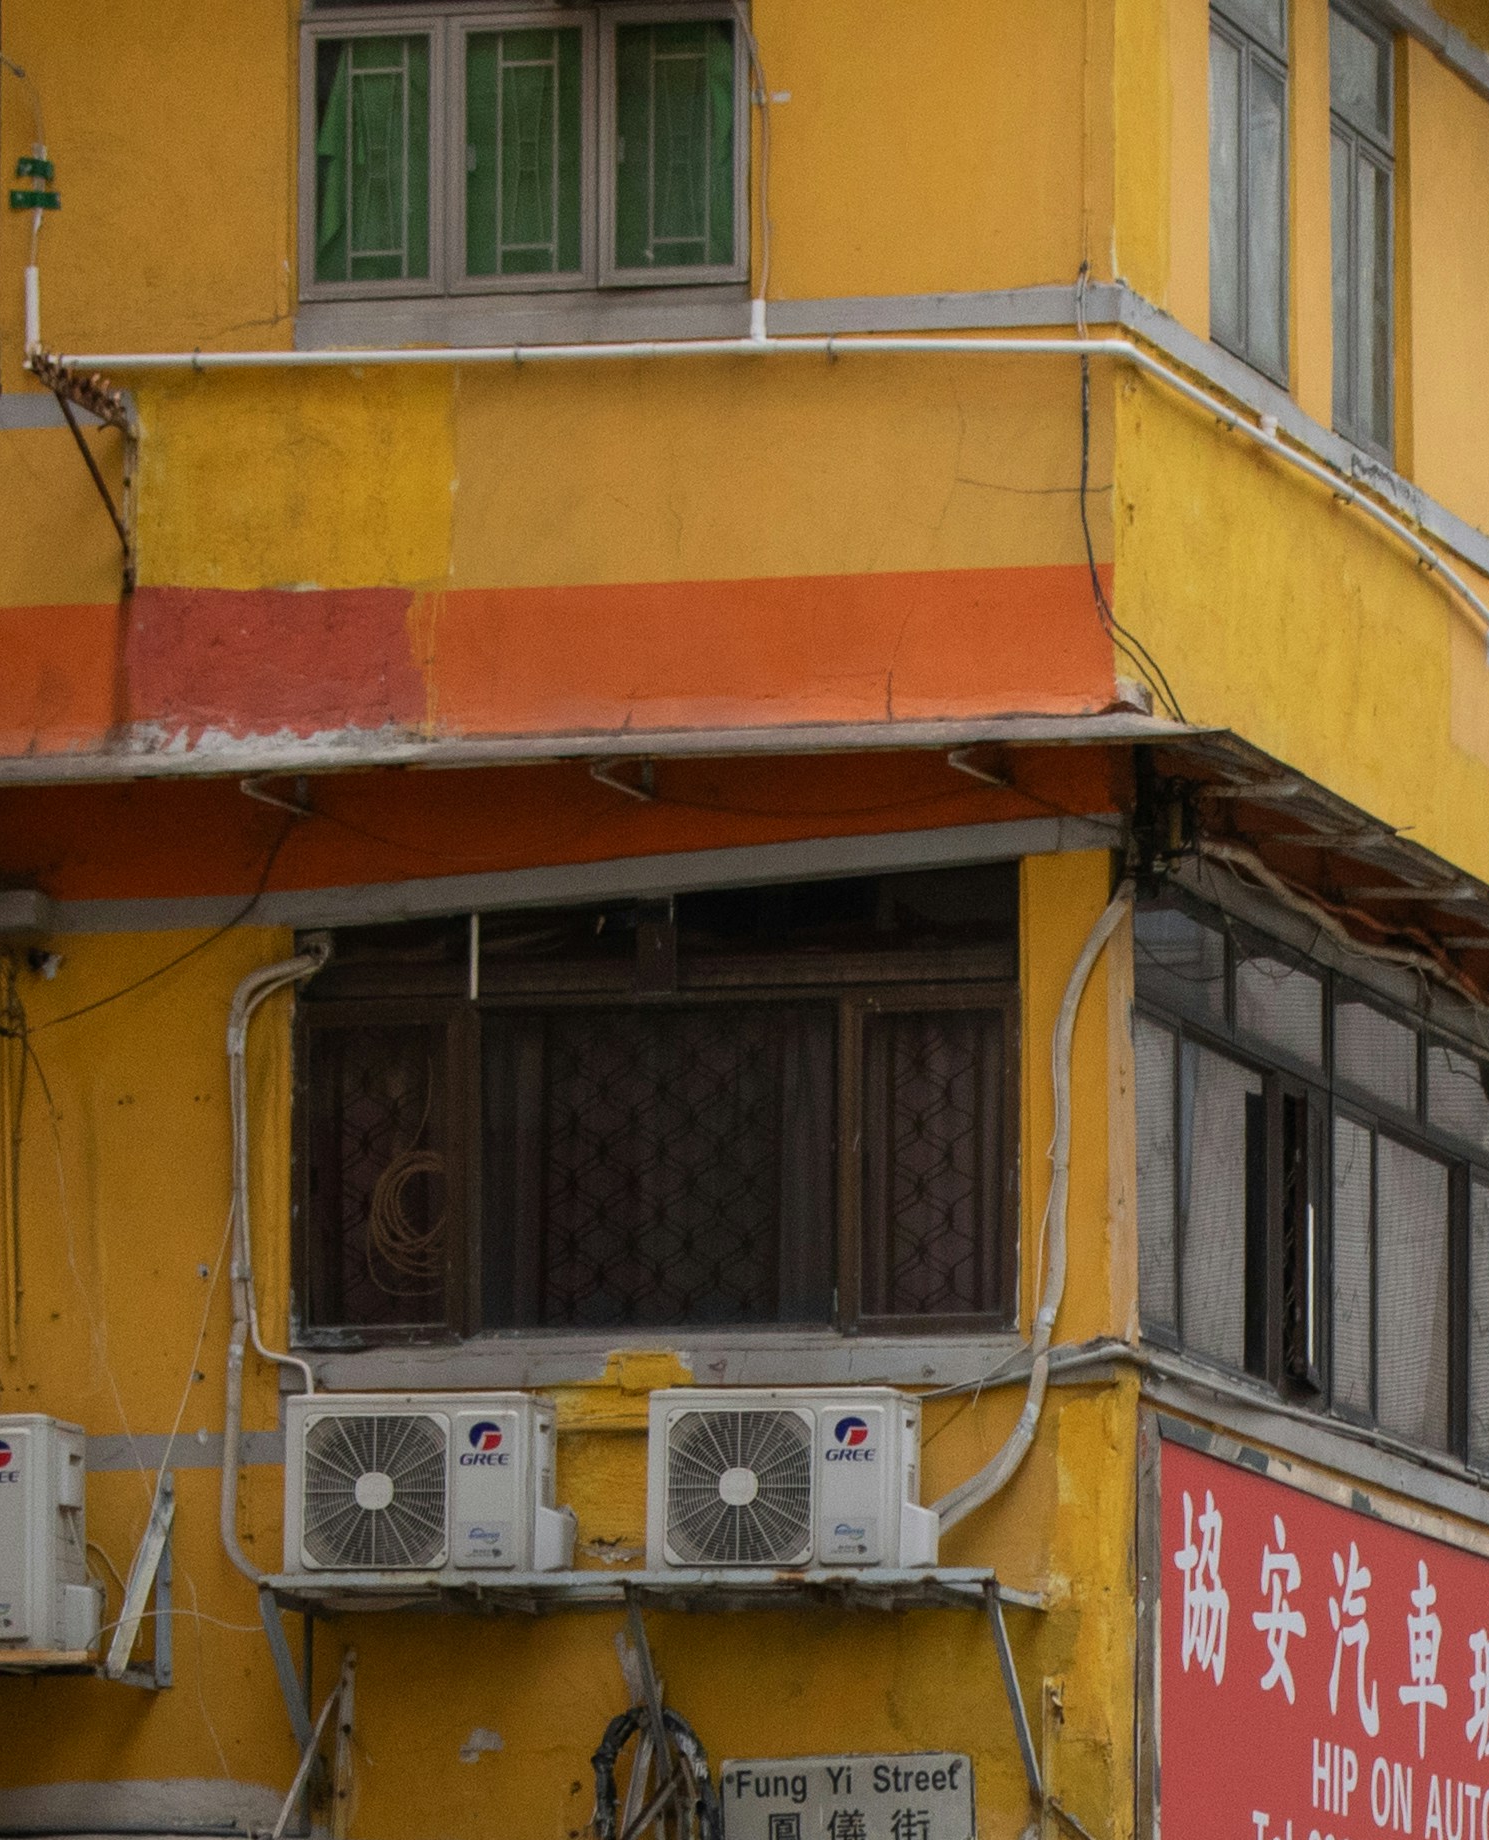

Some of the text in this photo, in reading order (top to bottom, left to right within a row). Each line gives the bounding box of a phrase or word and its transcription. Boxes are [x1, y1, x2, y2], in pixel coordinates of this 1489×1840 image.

[459, 1452, 510, 1466] GREE
[825, 1448, 877, 1462] GREE
[735, 1762, 960, 1804] Fung Yi Street
[1312, 1738, 1358, 1817] HIP
[1370, 1750, 1413, 1834] ON
